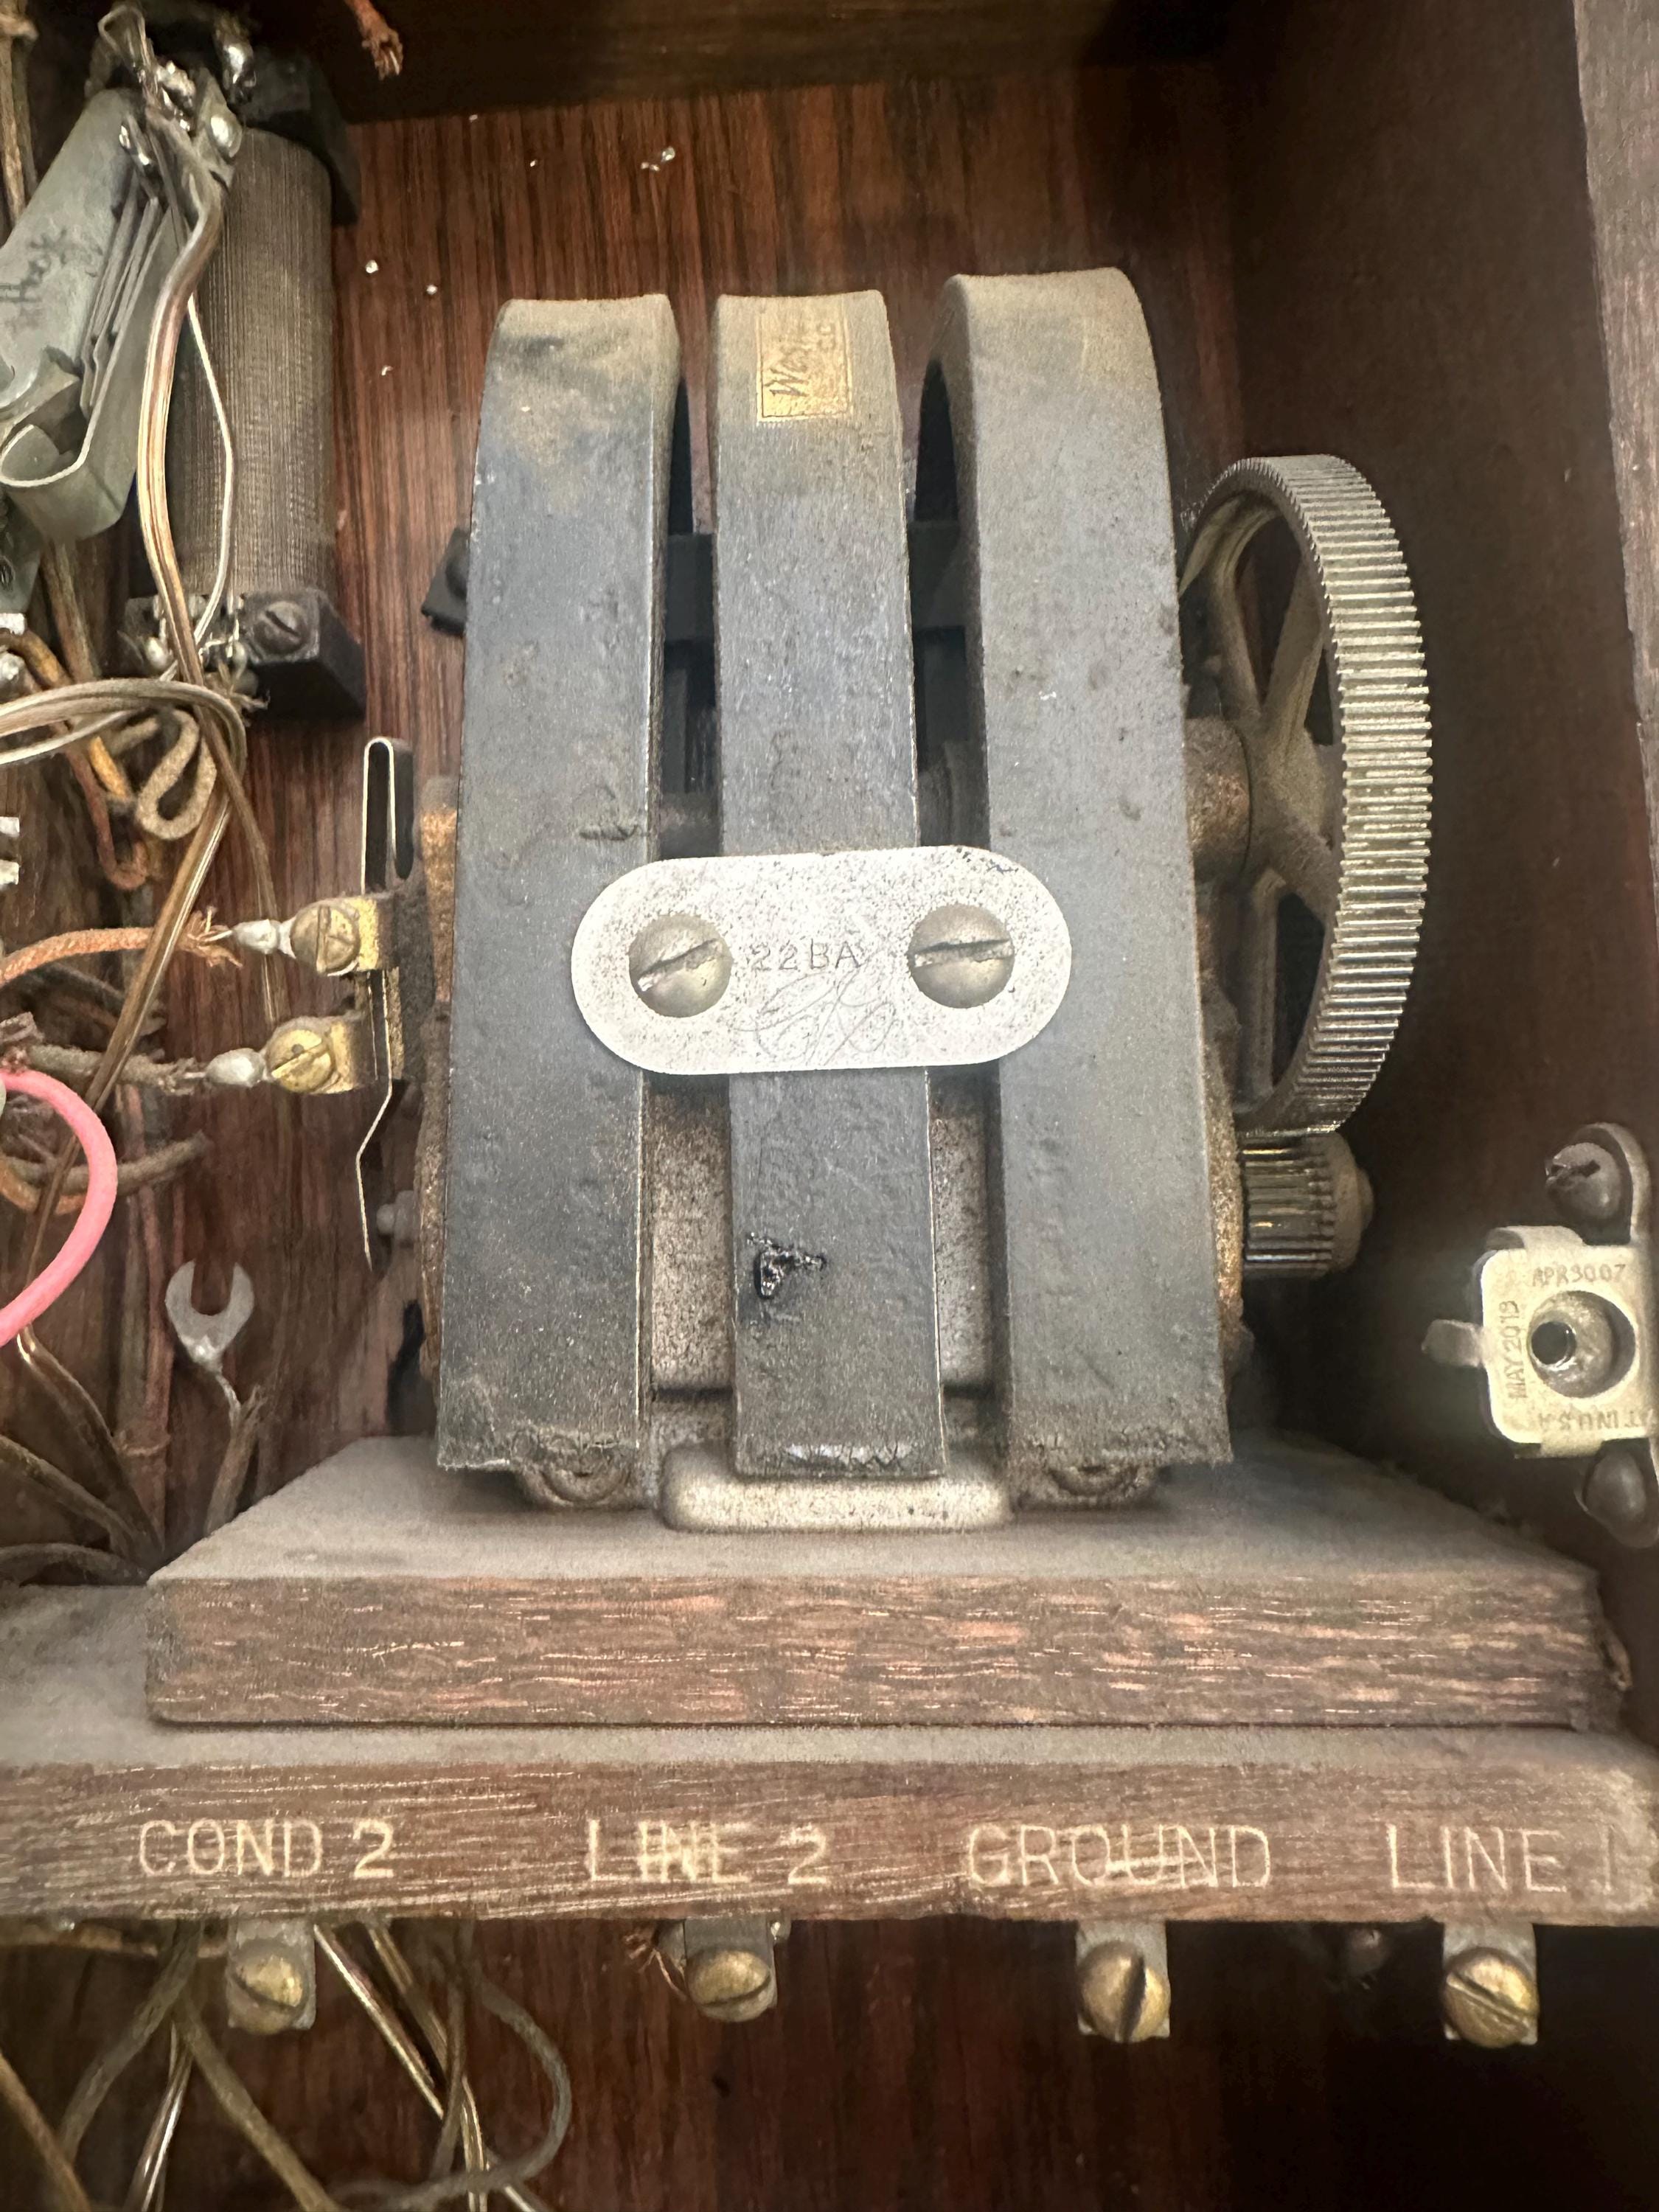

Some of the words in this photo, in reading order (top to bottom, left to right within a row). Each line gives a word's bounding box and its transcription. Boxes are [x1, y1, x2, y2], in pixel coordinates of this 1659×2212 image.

[139, 1818, 322, 1877] COND
[352, 1819, 395, 1878] 2
[586, 1818, 752, 1884] LINE
[783, 1825, 827, 1885] 2
[967, 1823, 1271, 1888] GROUND
[1387, 1823, 1567, 1893] LINE
